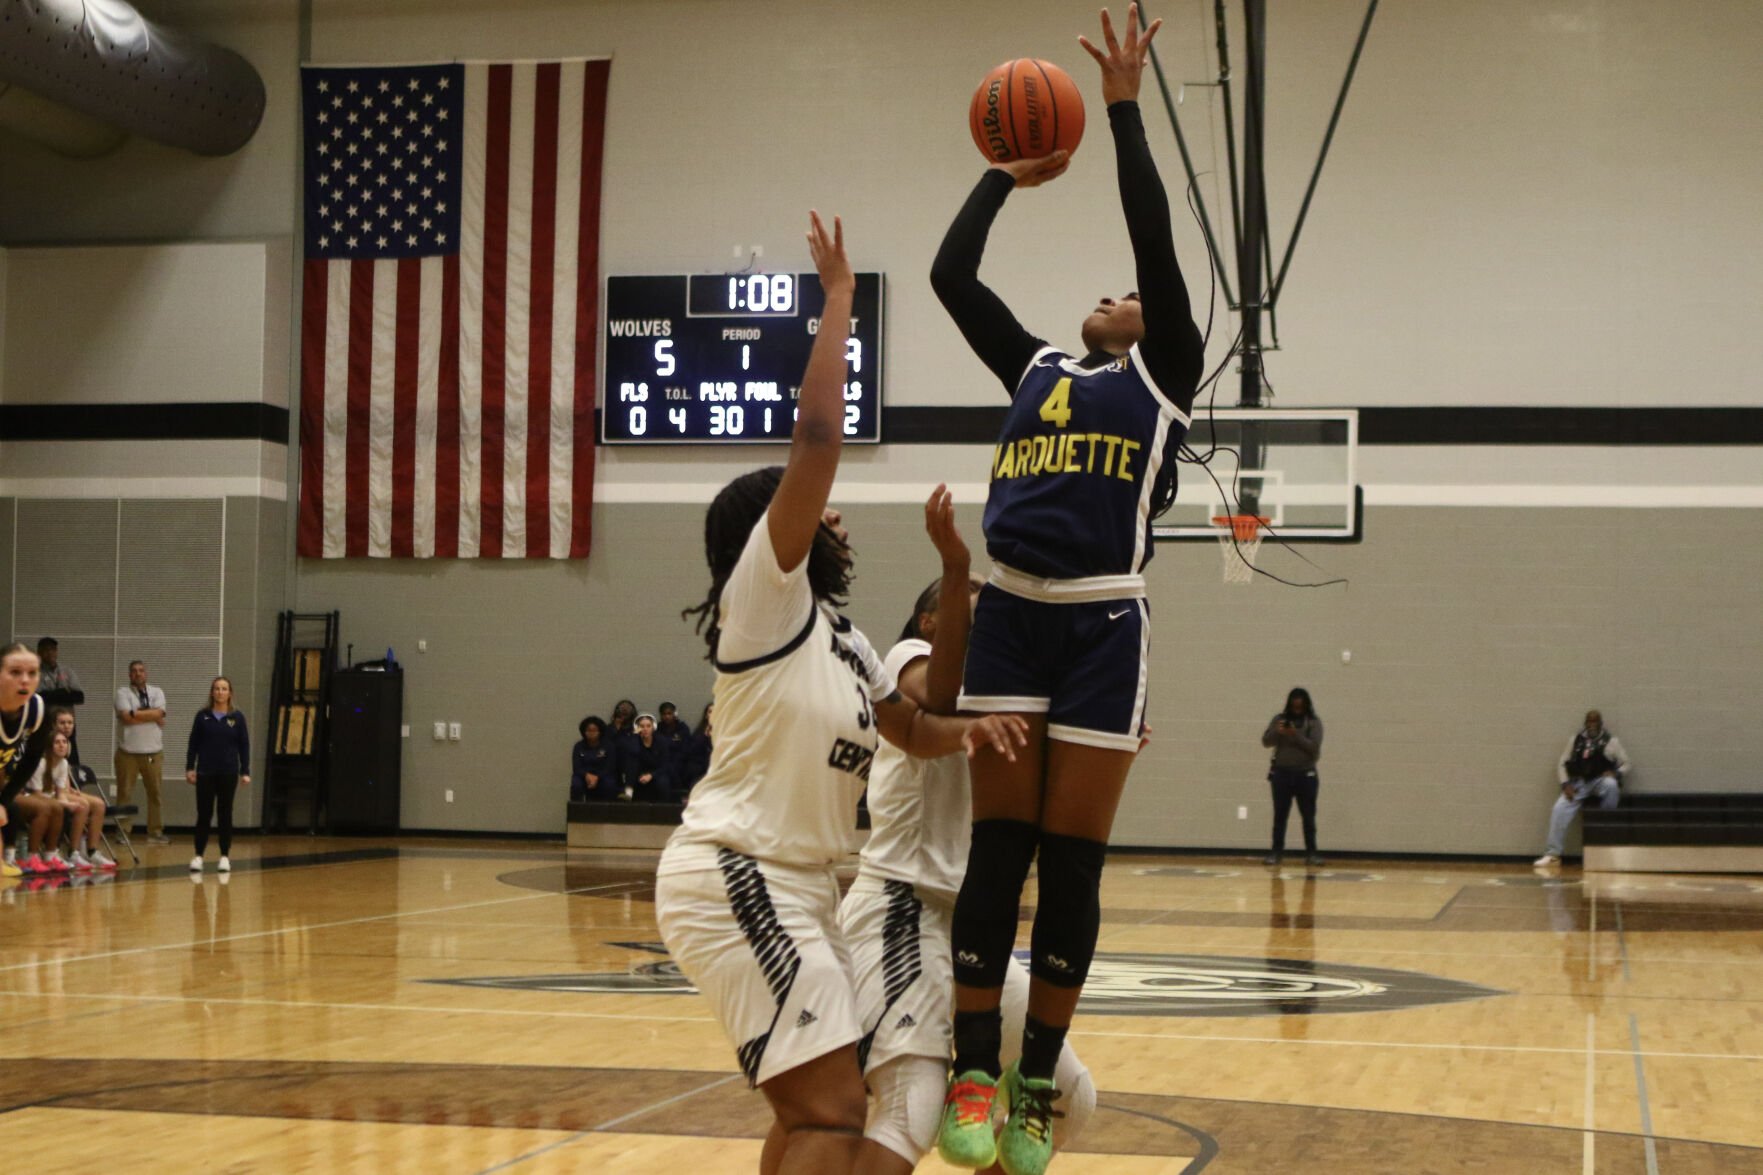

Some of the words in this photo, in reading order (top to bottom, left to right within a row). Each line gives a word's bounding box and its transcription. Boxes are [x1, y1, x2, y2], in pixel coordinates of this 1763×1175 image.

[983, 79, 1011, 159] Wilson
[728, 274, 793, 312] 1:08
[609, 319, 672, 337] WOLVES
[722, 328, 761, 341] PERIOD
[654, 339, 676, 377] 5
[742, 344, 750, 370] 1
[620, 382, 649, 402] FLS
[665, 388, 692, 400] T.O.L.
[700, 381, 738, 402] PLYR
[744, 381, 783, 402] FOUL
[842, 381, 863, 401] LS
[1039, 377, 1072, 428] 4
[629, 406, 647, 435] 0
[668, 407, 687, 433] 4
[709, 405, 744, 435] 30
[764, 407, 772, 433] 1
